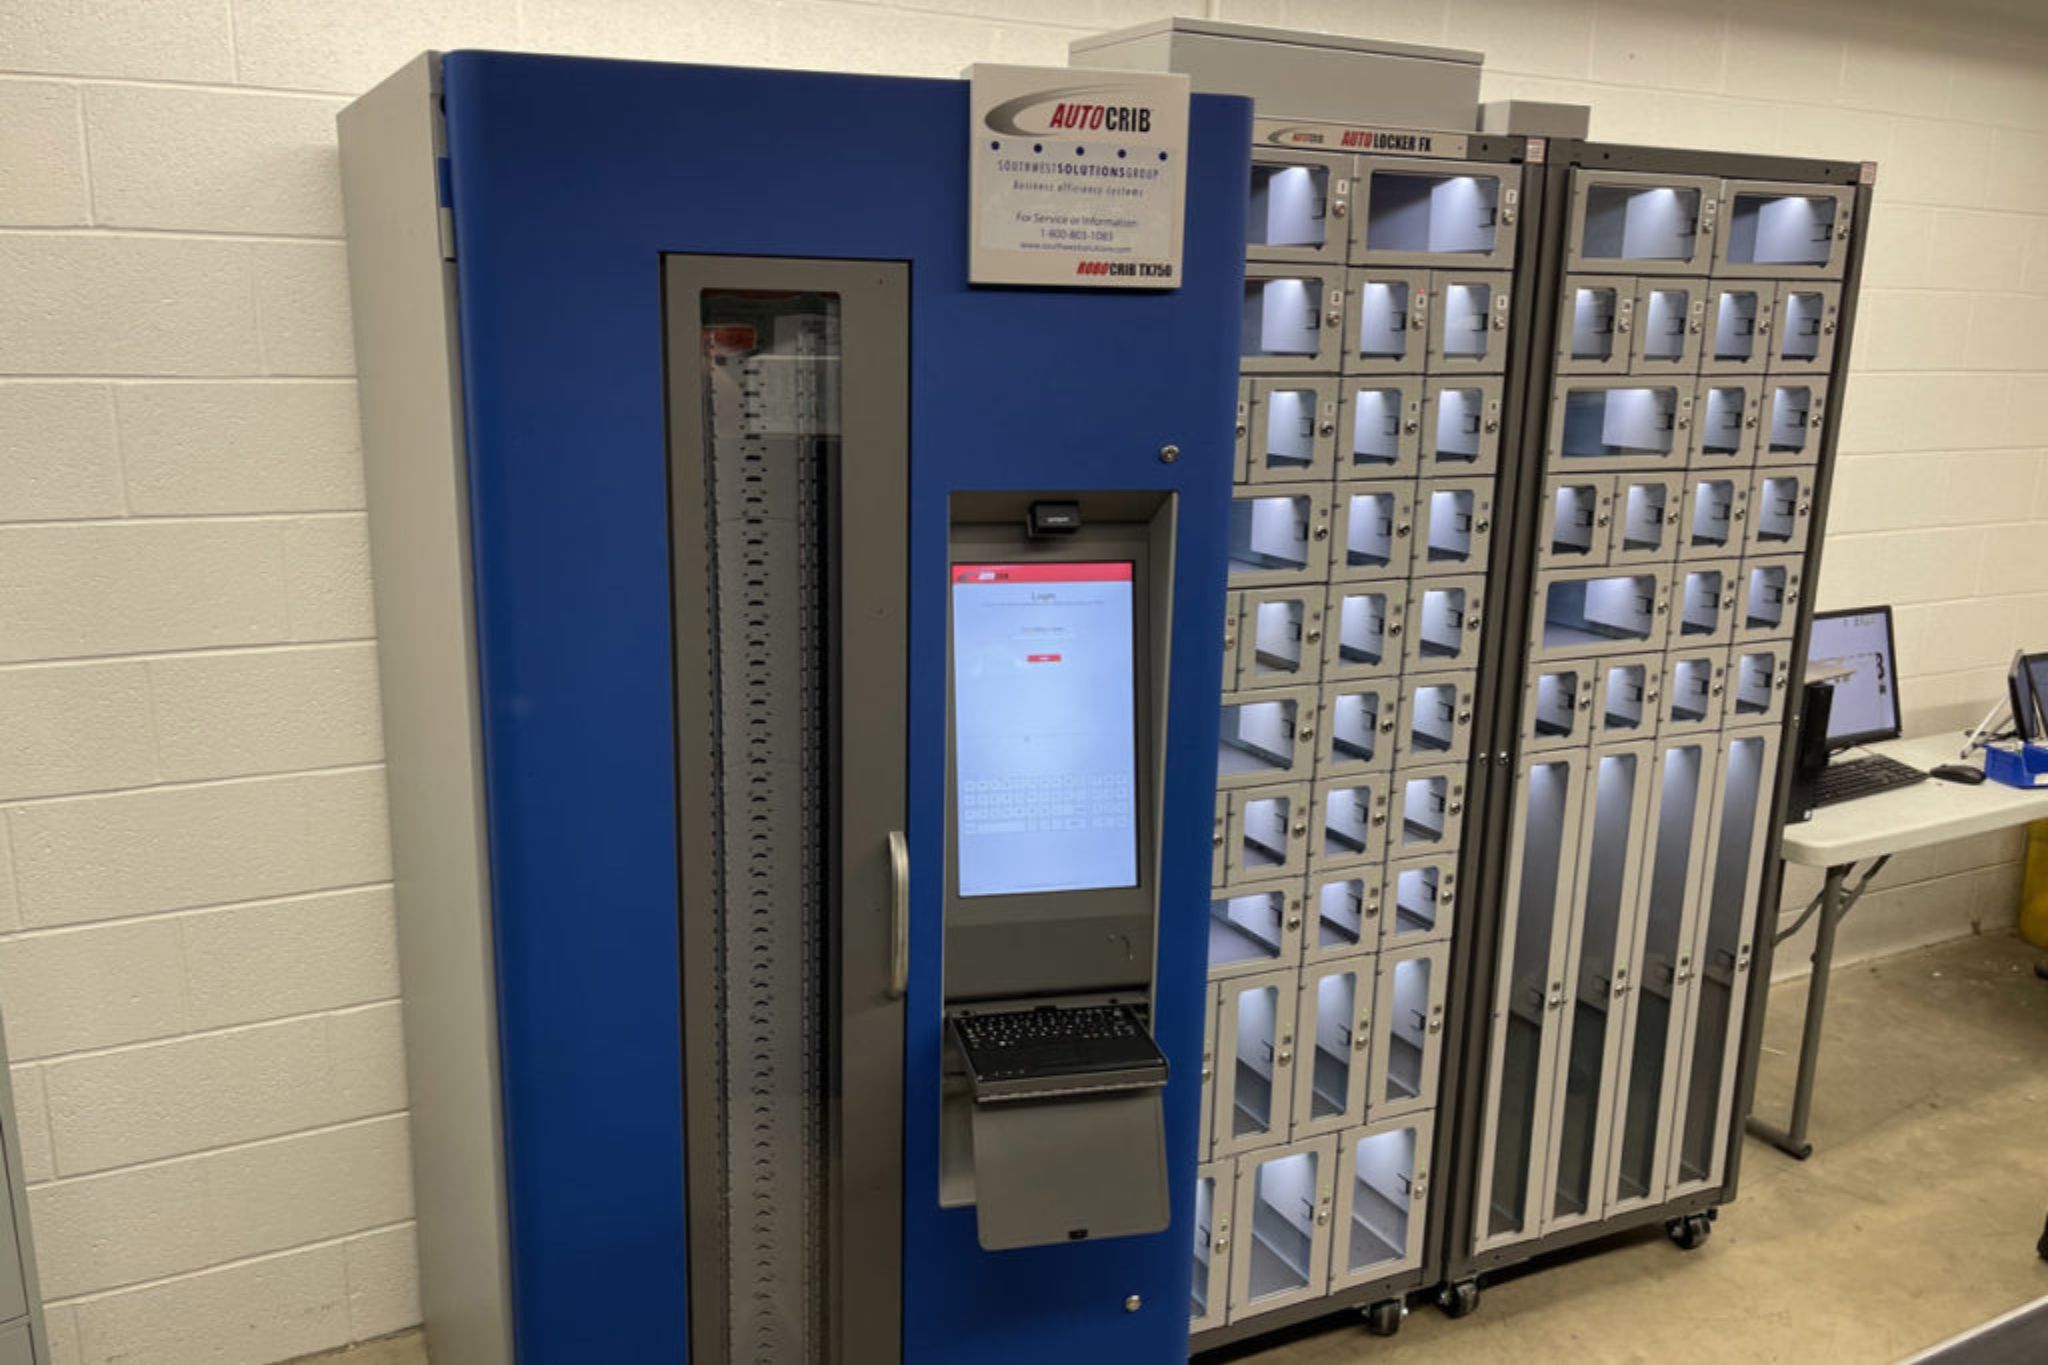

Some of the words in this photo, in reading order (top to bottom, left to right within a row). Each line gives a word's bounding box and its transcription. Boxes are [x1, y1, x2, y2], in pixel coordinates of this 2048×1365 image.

[1049, 103, 1152, 133] AUTOCRIB
[1016, 211, 1031, 221] For
[1034, 213, 1067, 225] Service
[1070, 217, 1079, 225] or
[1082, 215, 1137, 228] Information
[1076, 261, 1136, 276] ROBOCRIB
[1139, 262, 1173, 277] TX750
